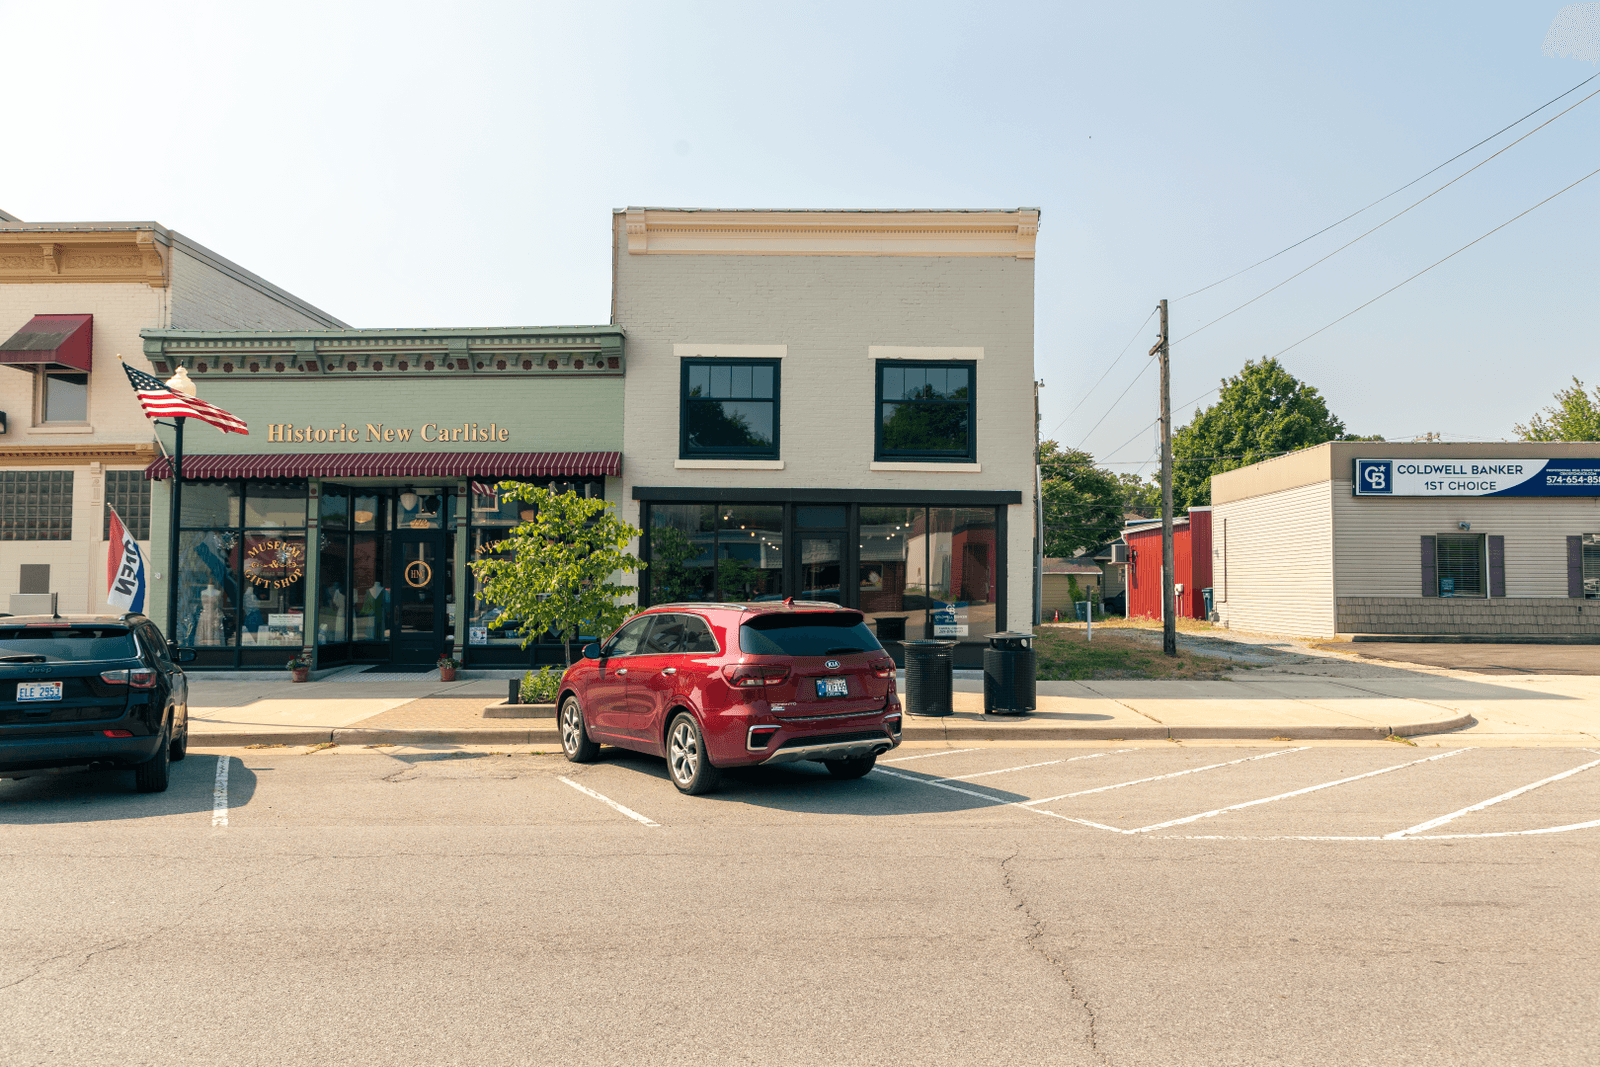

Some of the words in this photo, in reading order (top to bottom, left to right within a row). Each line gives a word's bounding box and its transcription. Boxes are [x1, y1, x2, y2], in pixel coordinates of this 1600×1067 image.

[267, 423, 359, 443] Historic
[365, 423, 413, 443] New
[420, 423, 509, 442] Carlisle
[1397, 464, 1467, 475] COLDWELL
[1471, 464, 1523, 475] BANKER
[1424, 481, 1444, 490] 1ST
[1448, 481, 1497, 490] CHOICE
[1546, 475, 1600, 484] 574-654-85
[247, 541, 301, 558] MUSEUM
[244, 569, 271, 589] GIFT
[273, 568, 302, 589] SHOP
[19, 687, 34, 698] ELE
[39, 686, 60, 697] 2953
